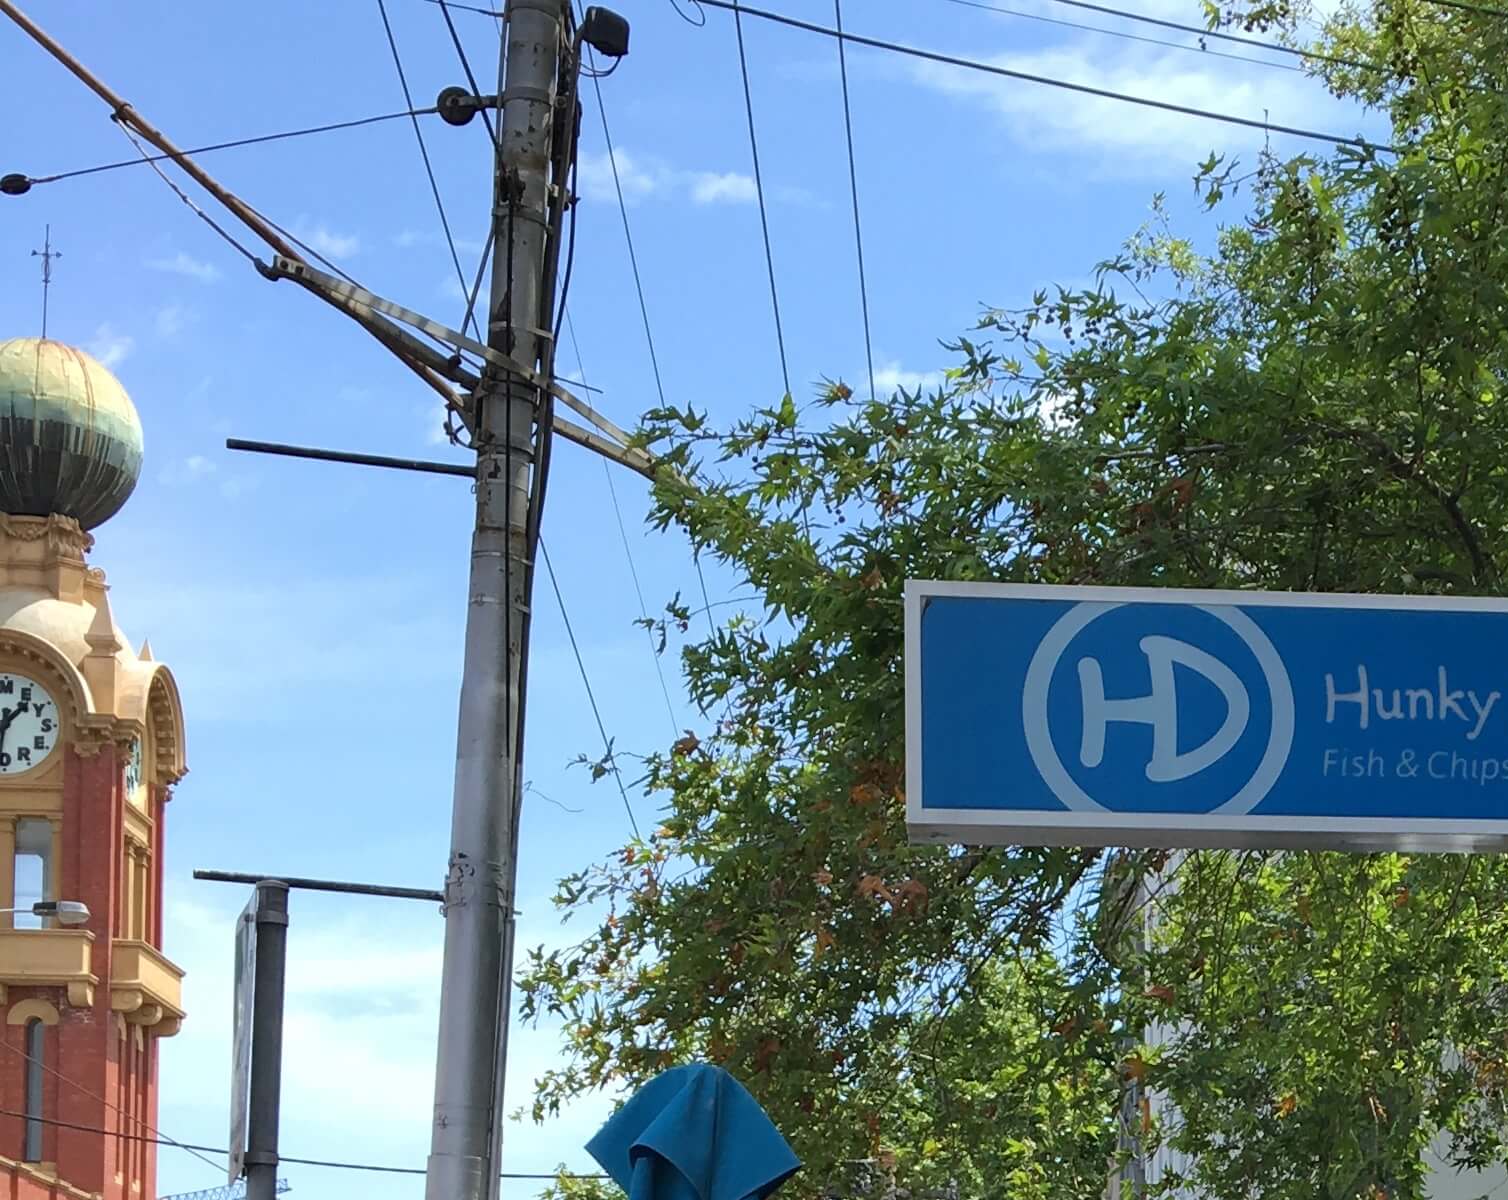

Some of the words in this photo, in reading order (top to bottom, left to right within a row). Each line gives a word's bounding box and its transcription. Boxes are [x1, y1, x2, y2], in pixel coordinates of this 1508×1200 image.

[1077, 635, 1250, 782] HD
[1324, 664, 1500, 740] Hunky
[1322, 748, 1385, 778] Fish
[1397, 749, 1418, 778] &
